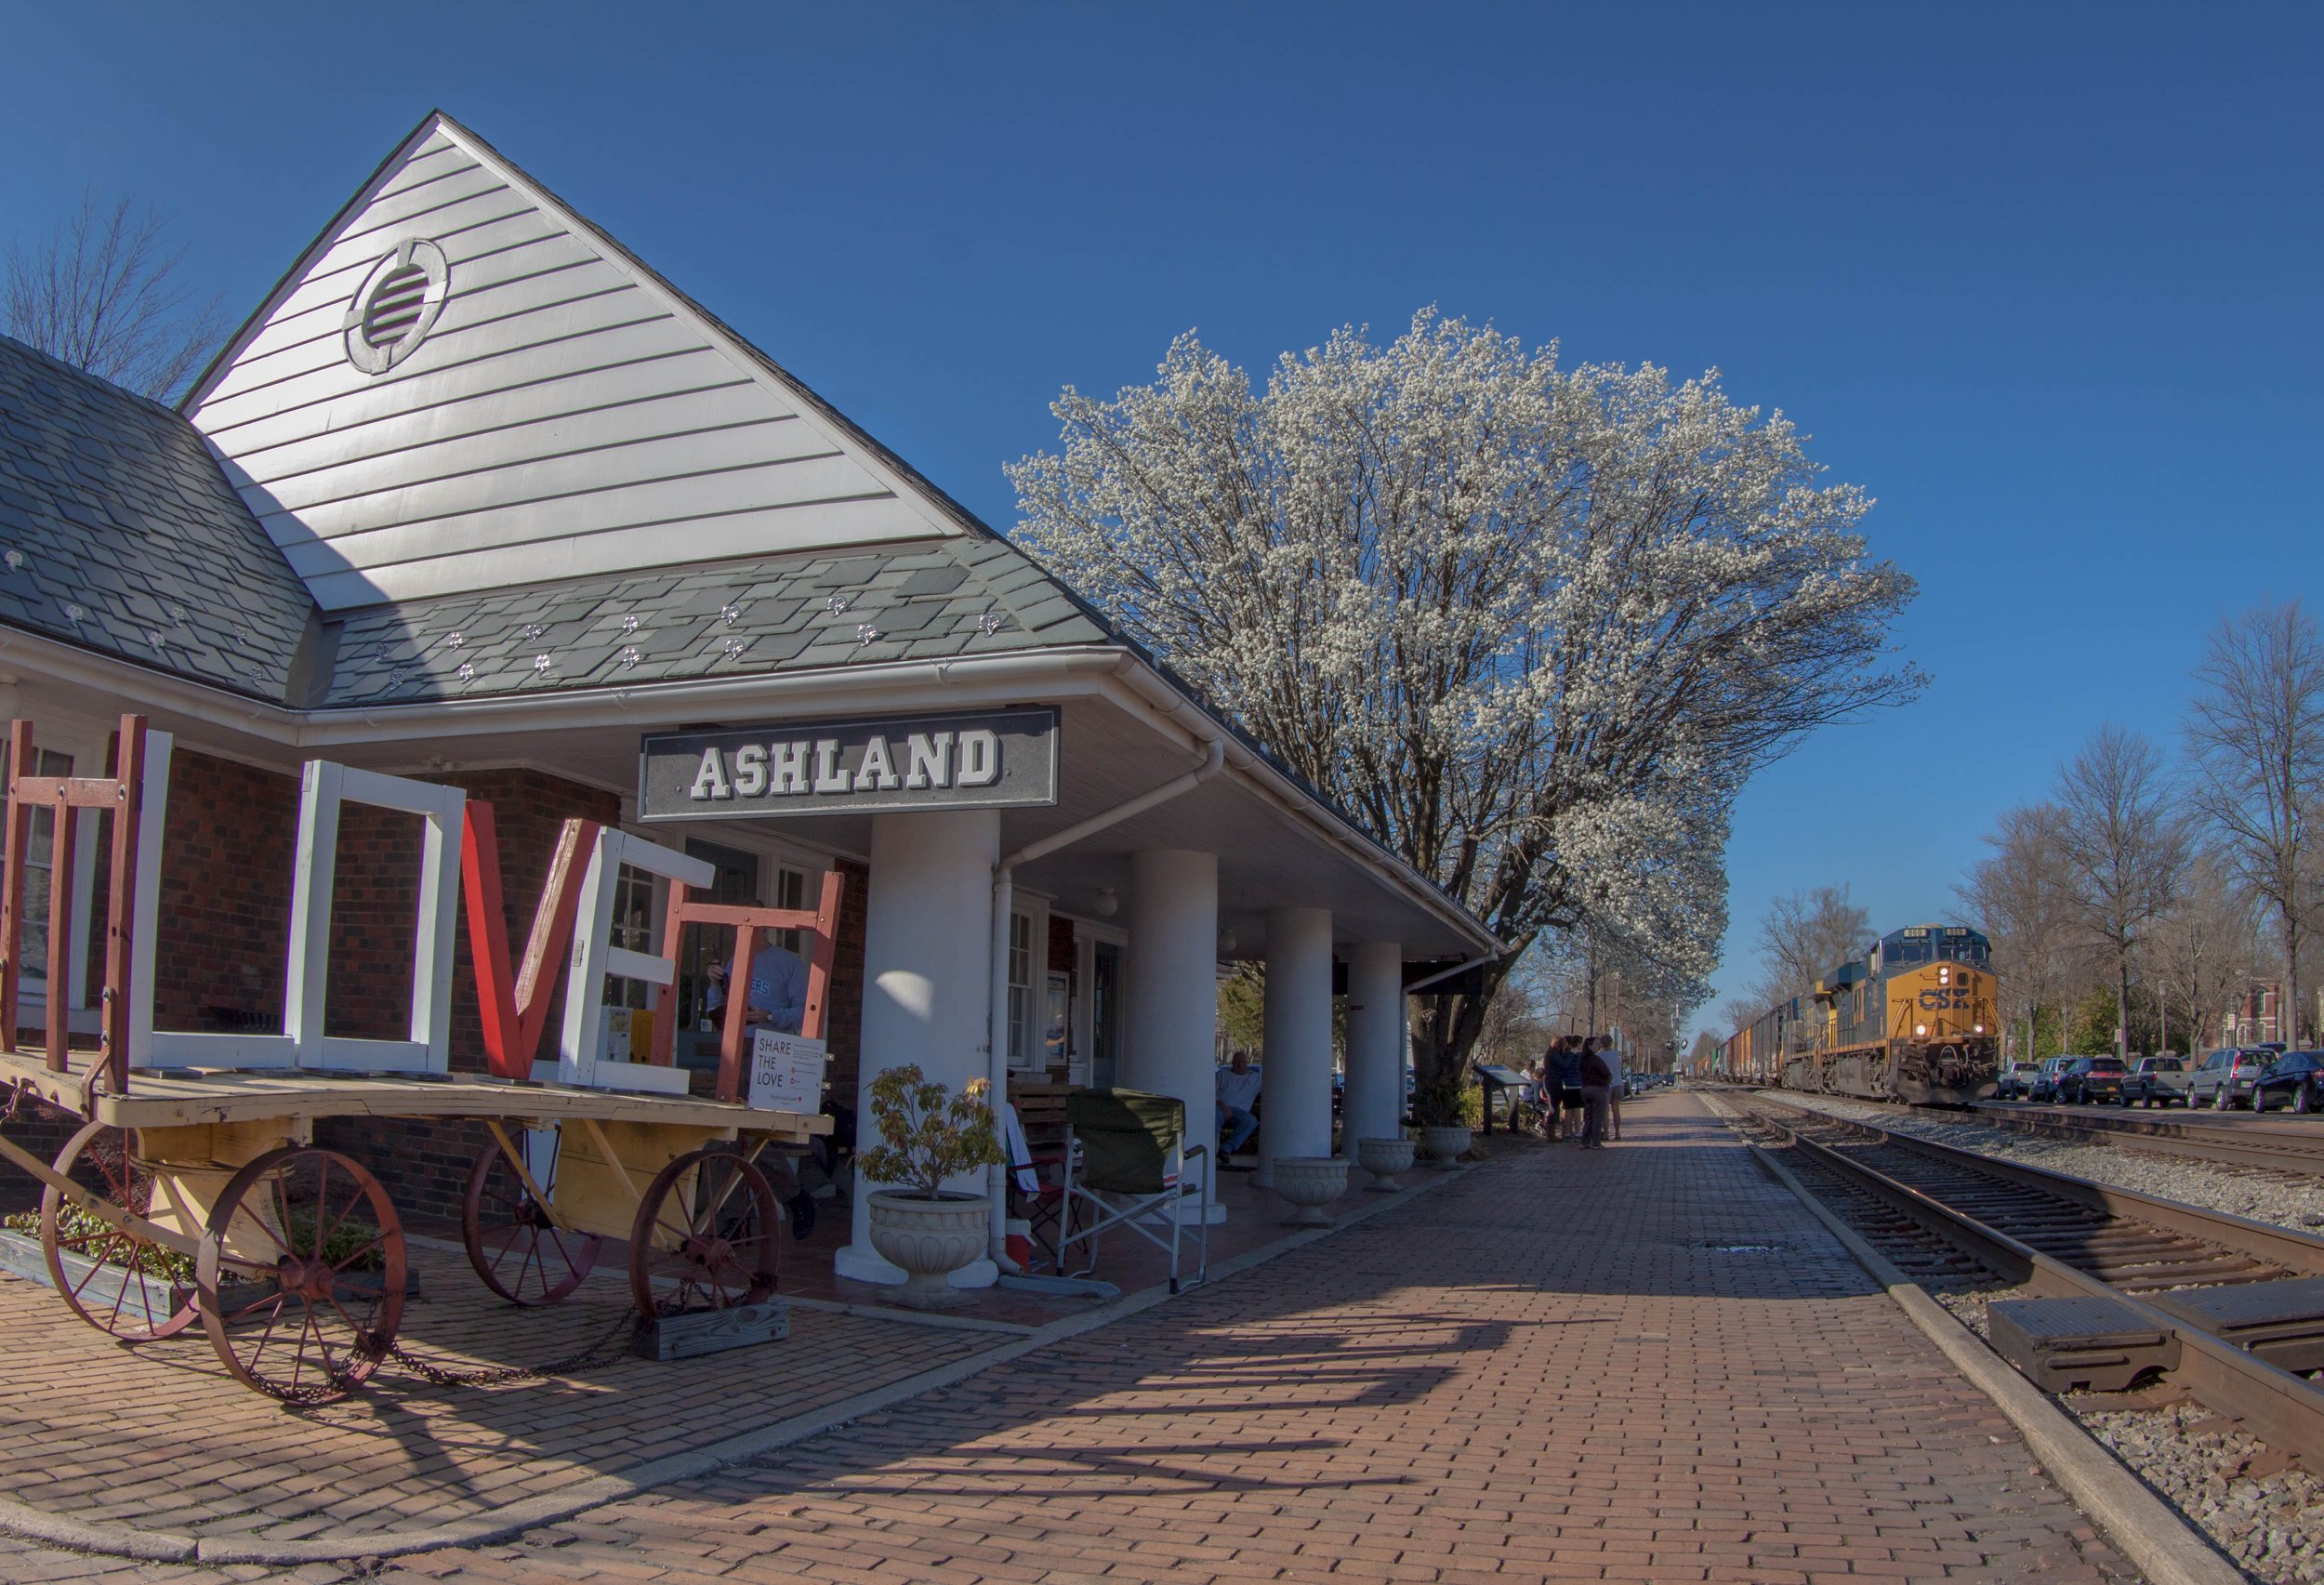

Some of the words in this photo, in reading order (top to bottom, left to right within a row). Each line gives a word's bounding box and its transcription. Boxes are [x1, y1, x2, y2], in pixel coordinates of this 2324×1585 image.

[690, 731, 1000, 800] ASHLAND
[129, 731, 715, 1095] LOVE
[1919, 989, 1970, 1010] CSX
[759, 1038, 792, 1055] SHARE
[758, 1055, 776, 1070] THE
[757, 1072, 784, 1088] LOVE
